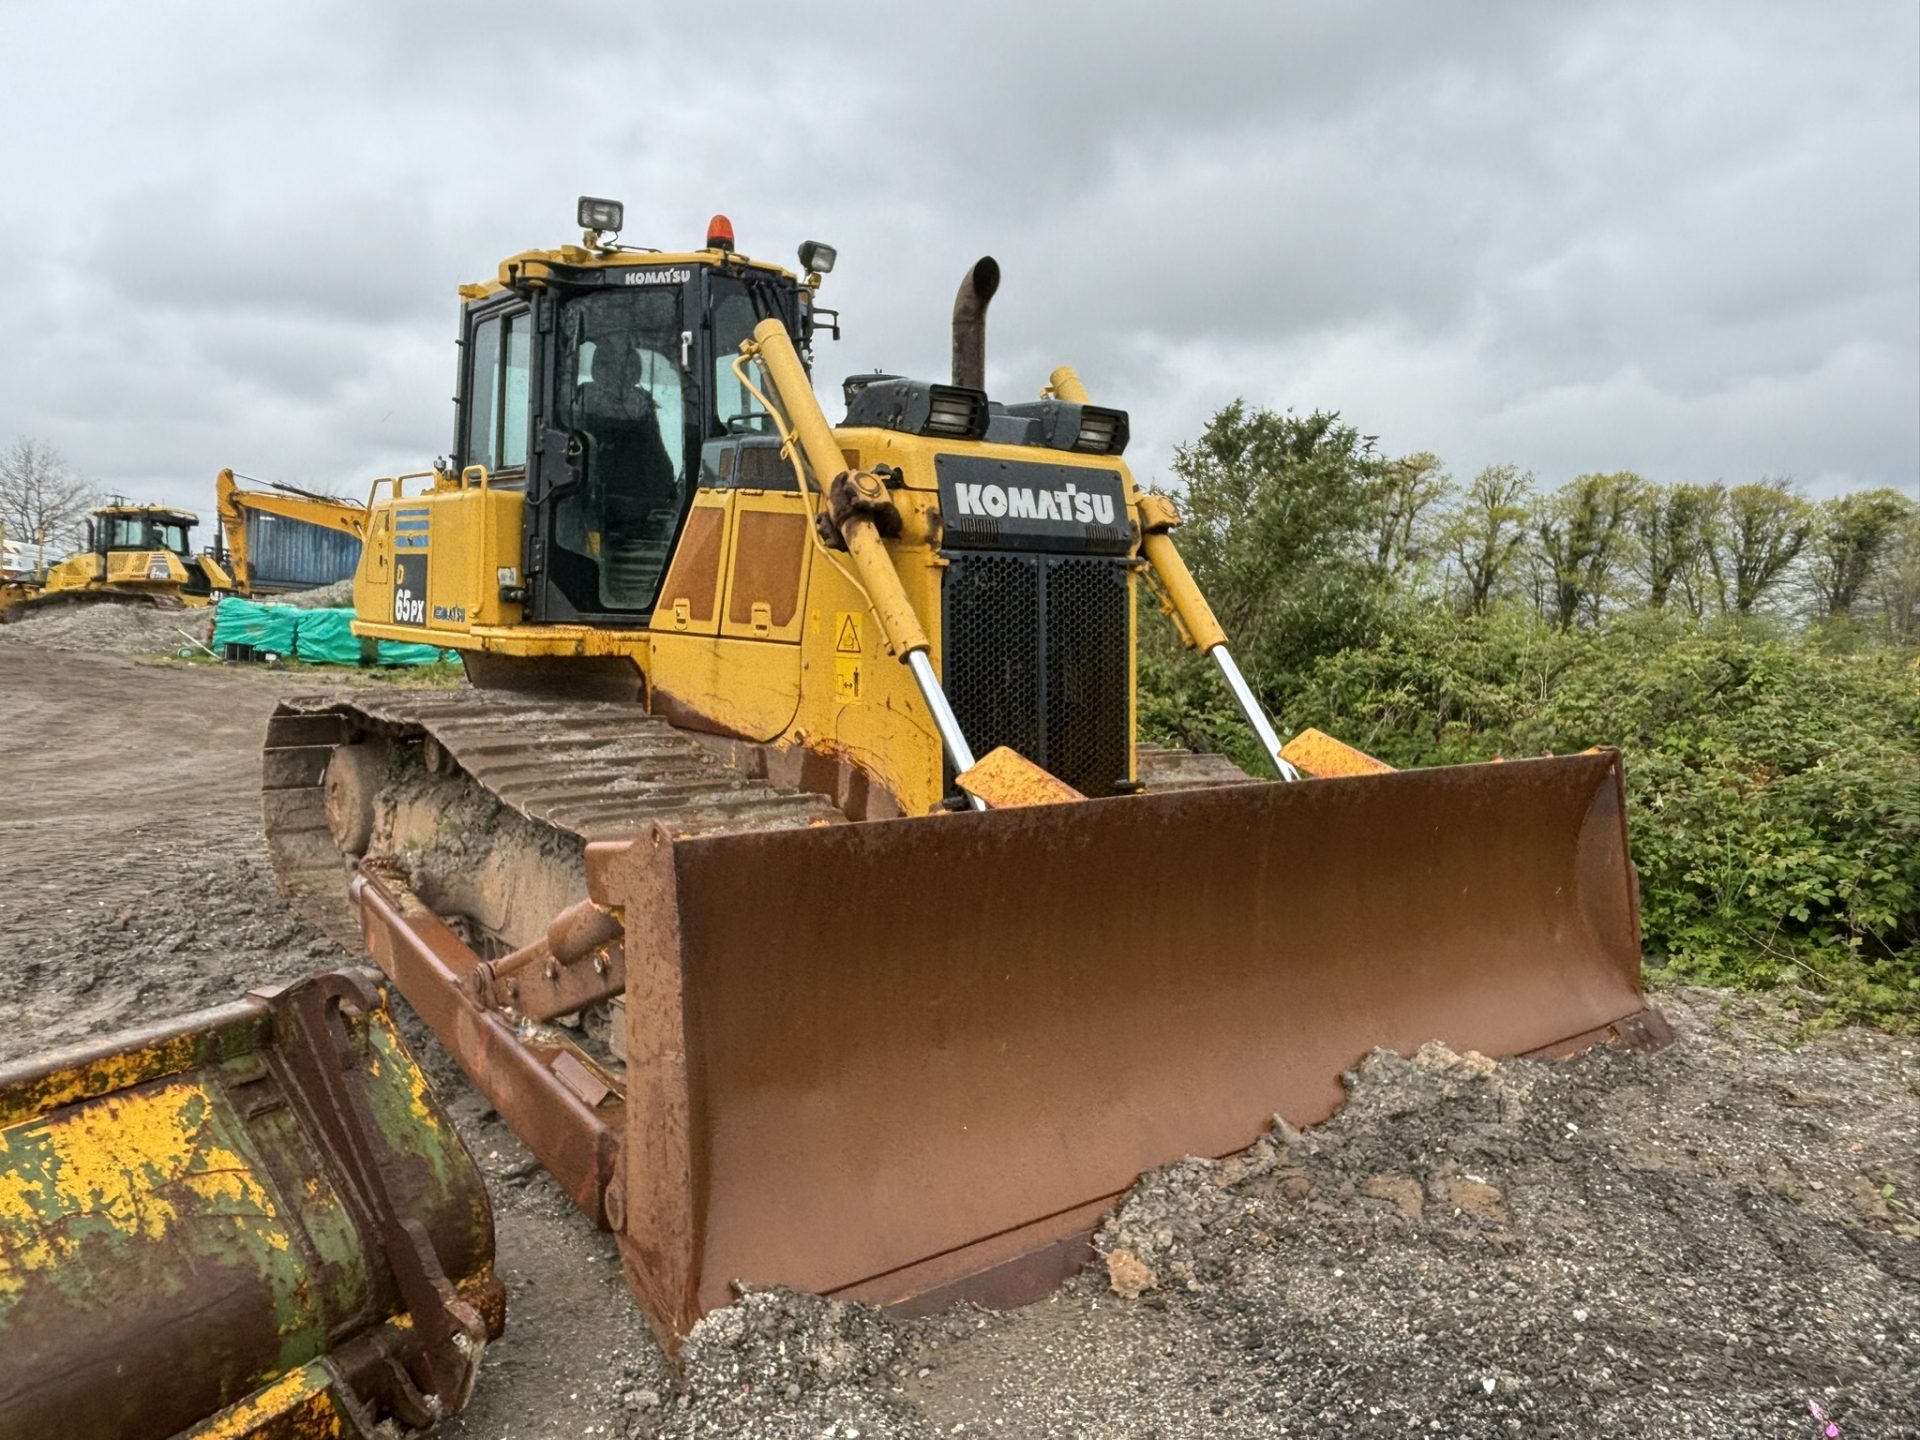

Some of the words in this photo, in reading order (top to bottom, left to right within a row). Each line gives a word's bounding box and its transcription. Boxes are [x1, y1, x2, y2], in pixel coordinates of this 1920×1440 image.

[625, 268, 690, 285] KOMATSU
[955, 483, 1114, 525] KOMATSU
[397, 564, 404, 584] D
[395, 588, 424, 623] 65PX
